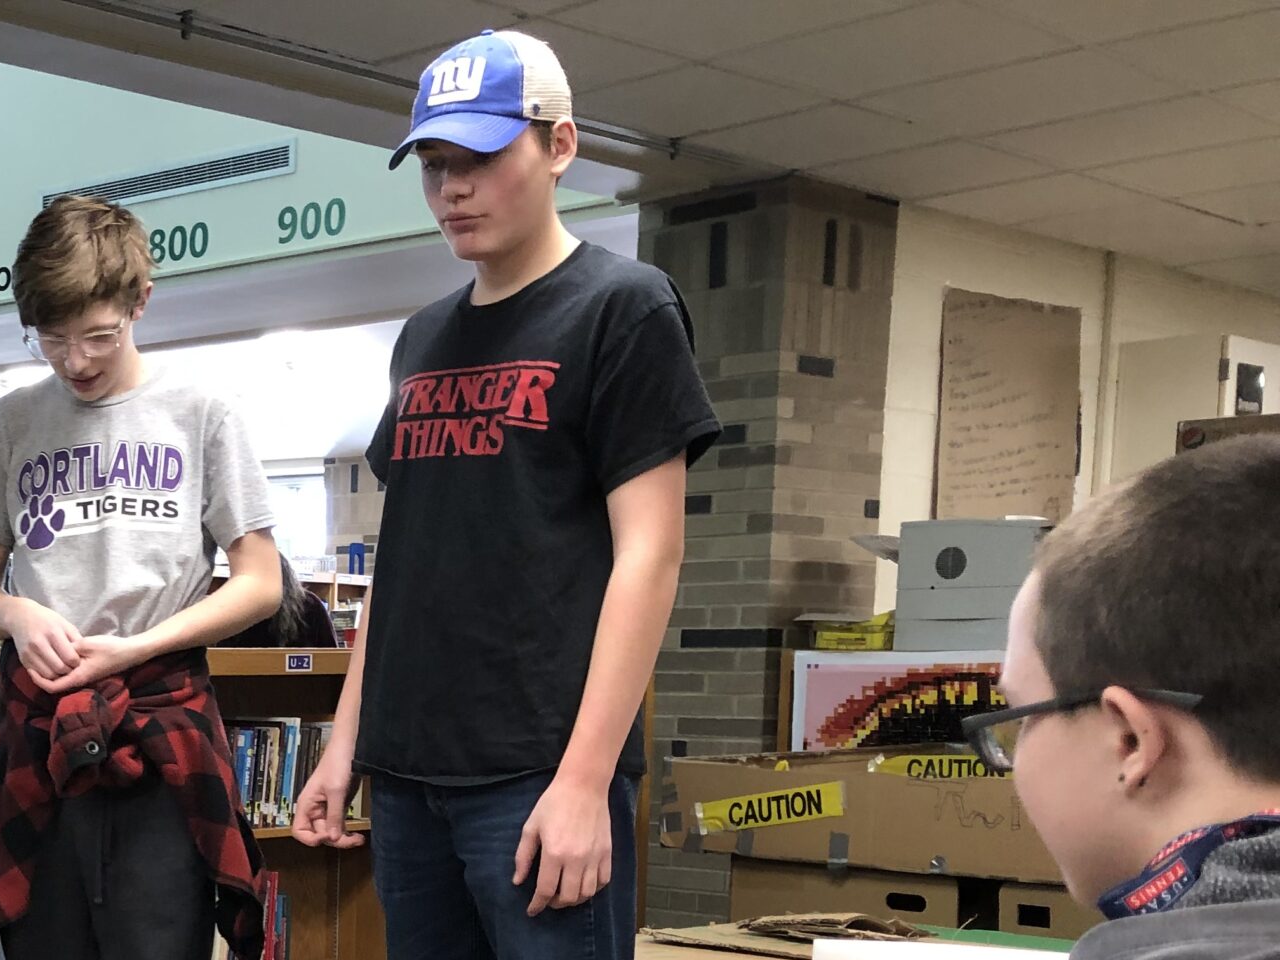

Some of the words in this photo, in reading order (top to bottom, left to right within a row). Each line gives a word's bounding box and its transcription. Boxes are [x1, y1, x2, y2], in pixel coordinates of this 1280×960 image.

[150, 221, 209, 263] 800
[278, 198, 346, 244] 900
[399, 368, 556, 423] TRANGER
[391, 415, 505, 461] THINGS
[18, 440, 185, 505] CORTLAND
[76, 495, 179, 520] TIGERS
[907, 758, 1006, 779] CAUTION
[728, 790, 823, 827] CAUTION
[1127, 862, 1186, 909] TENNIS
